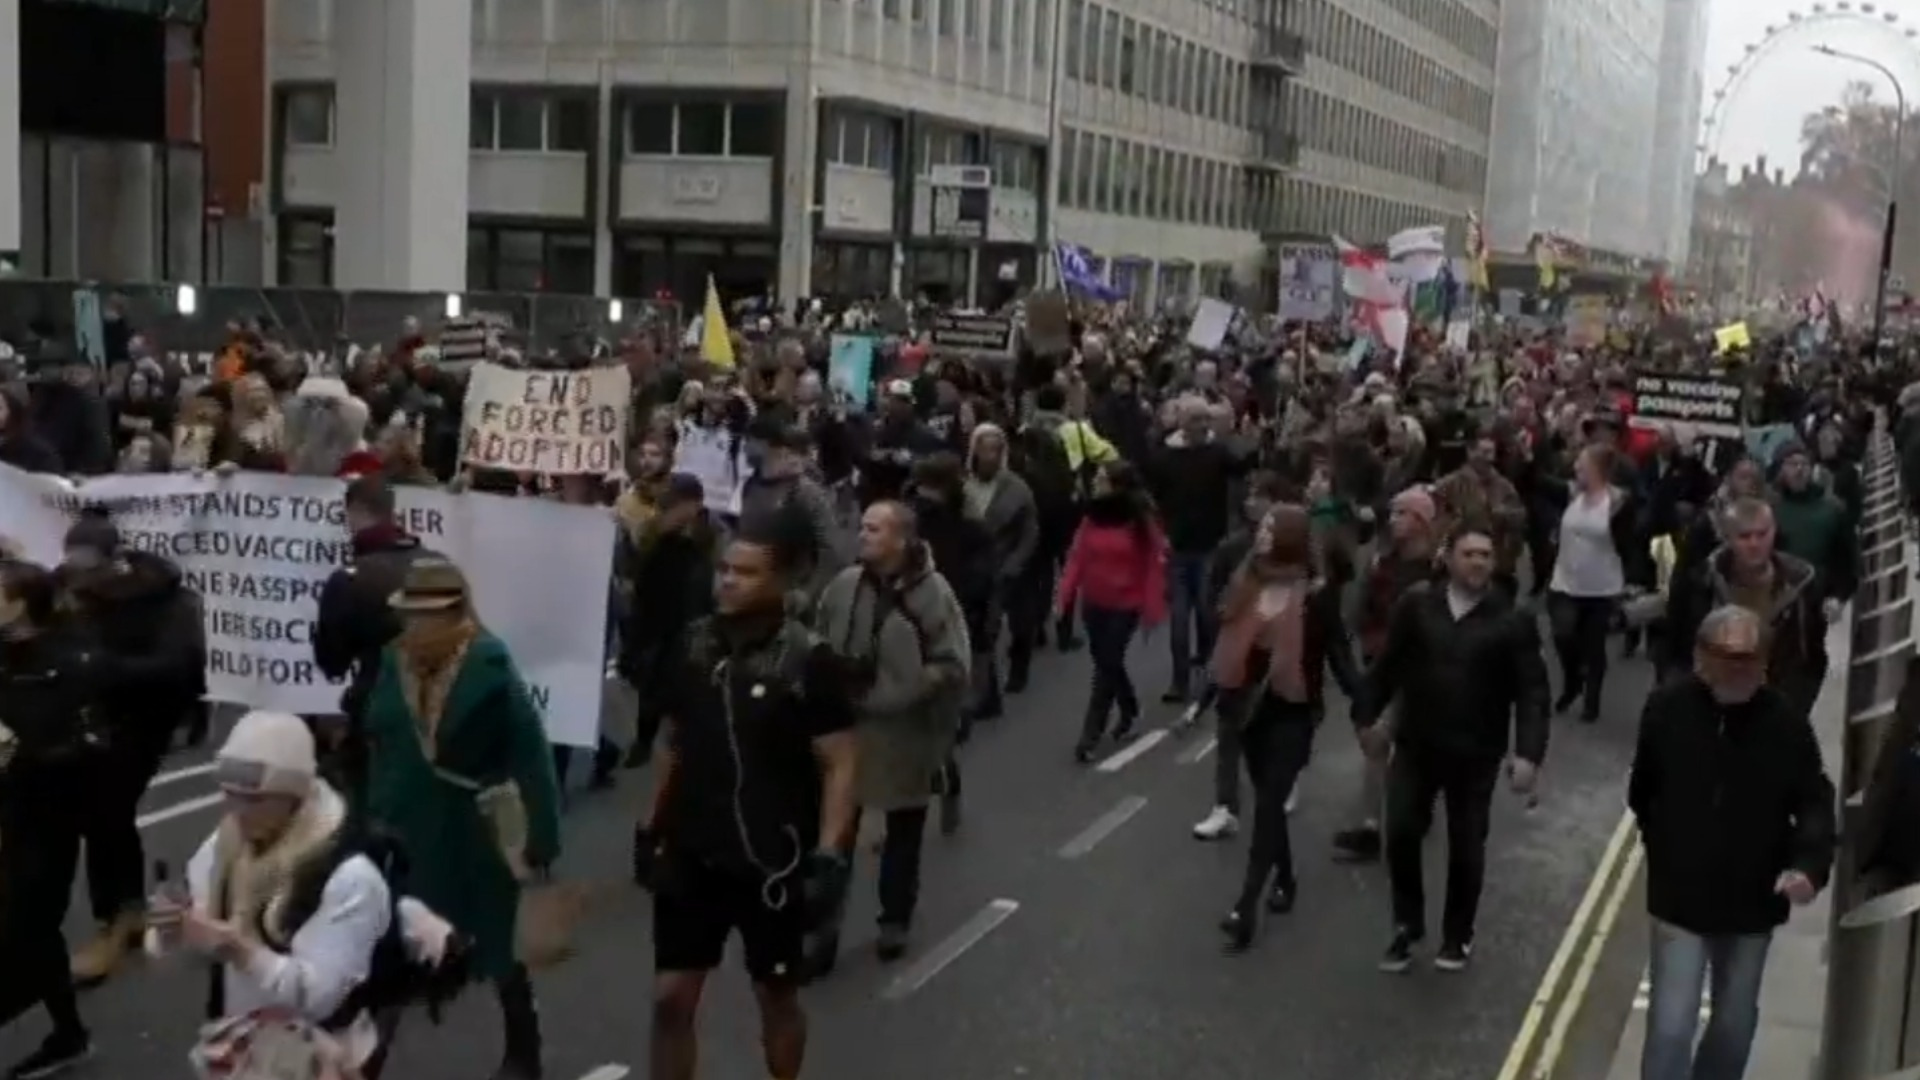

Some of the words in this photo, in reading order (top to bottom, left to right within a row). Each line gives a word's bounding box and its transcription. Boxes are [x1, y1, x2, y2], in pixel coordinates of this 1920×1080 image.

[525, 374, 592, 405] END
[1636, 376, 1662, 392] no
[482, 401, 617, 436] FORCED
[466, 427, 622, 470] ADOPTION
[171, 491, 280, 519] STANDS
[290, 496, 444, 535] TOGHER
[257, 653, 313, 686] FOR
